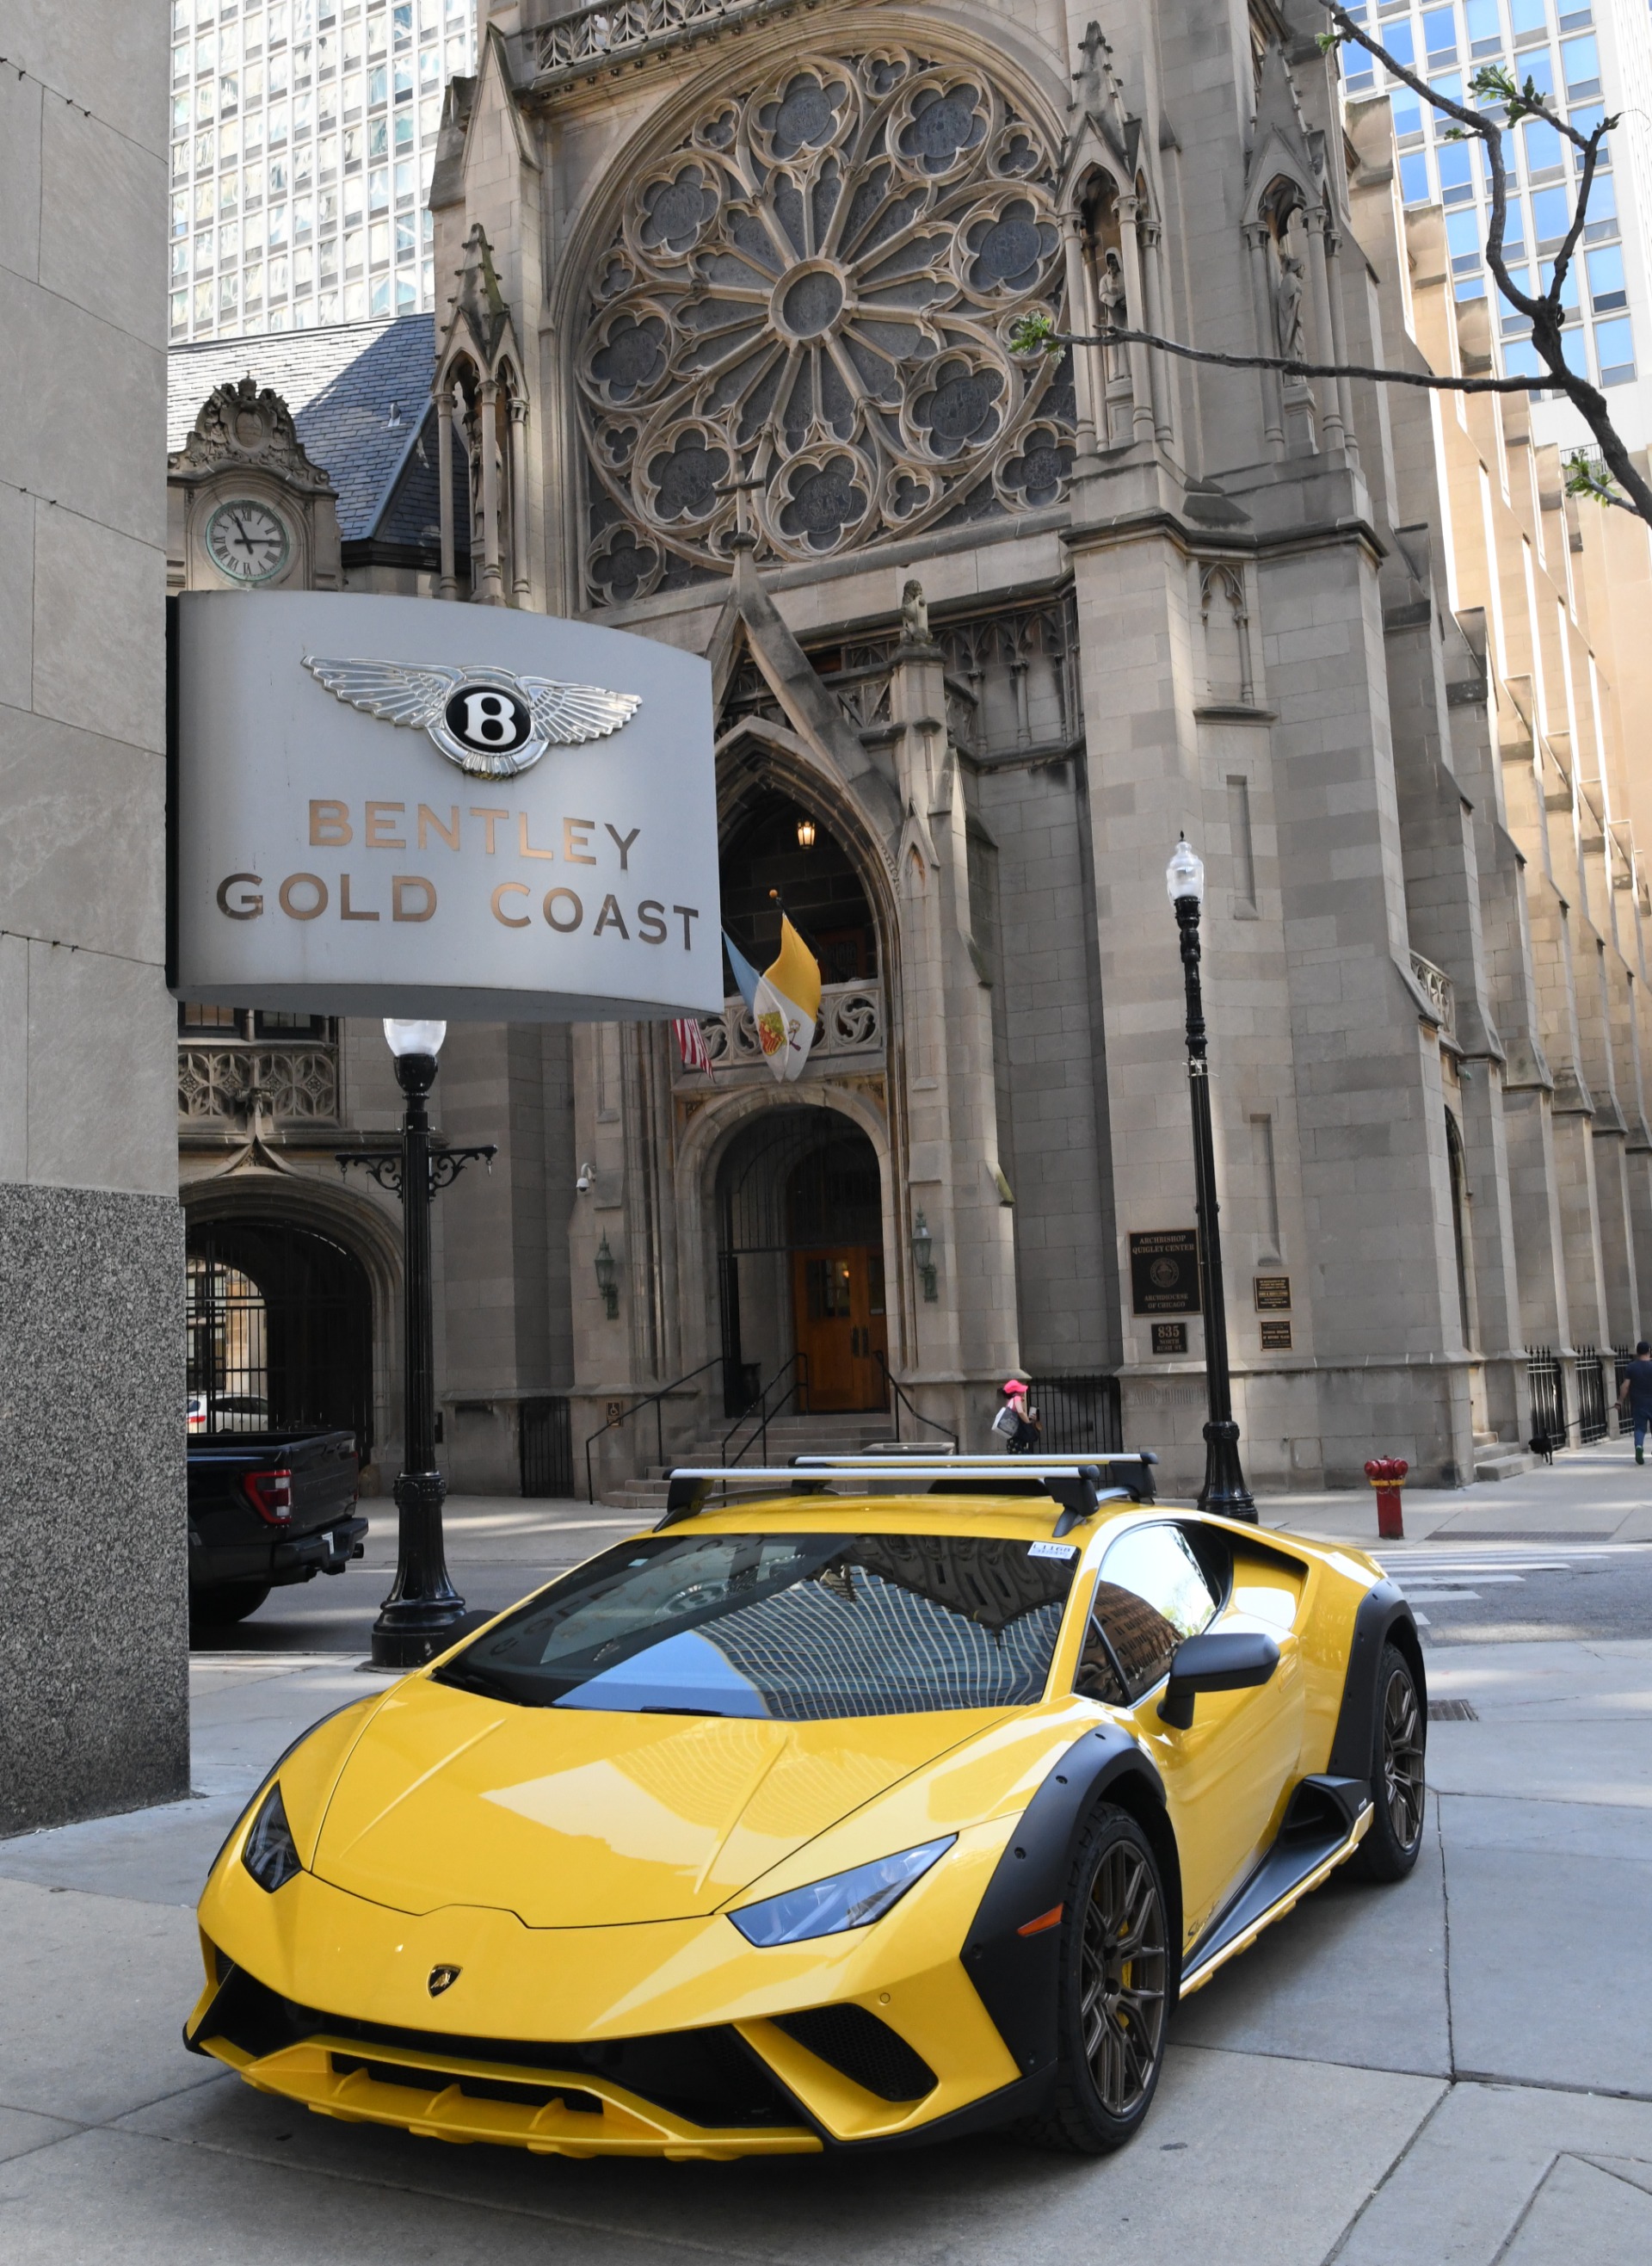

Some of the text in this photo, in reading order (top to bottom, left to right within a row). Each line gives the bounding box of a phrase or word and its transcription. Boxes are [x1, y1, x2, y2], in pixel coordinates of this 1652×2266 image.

[309, 799, 641, 870] BENTLEY
[216, 872, 700, 951] GOLD COAST
[1139, 1235, 1187, 1244] ARCHBISHOP
[1132, 1243, 1195, 1255] QUIGLEY CENTER
[1158, 1325, 1180, 1338] 835
